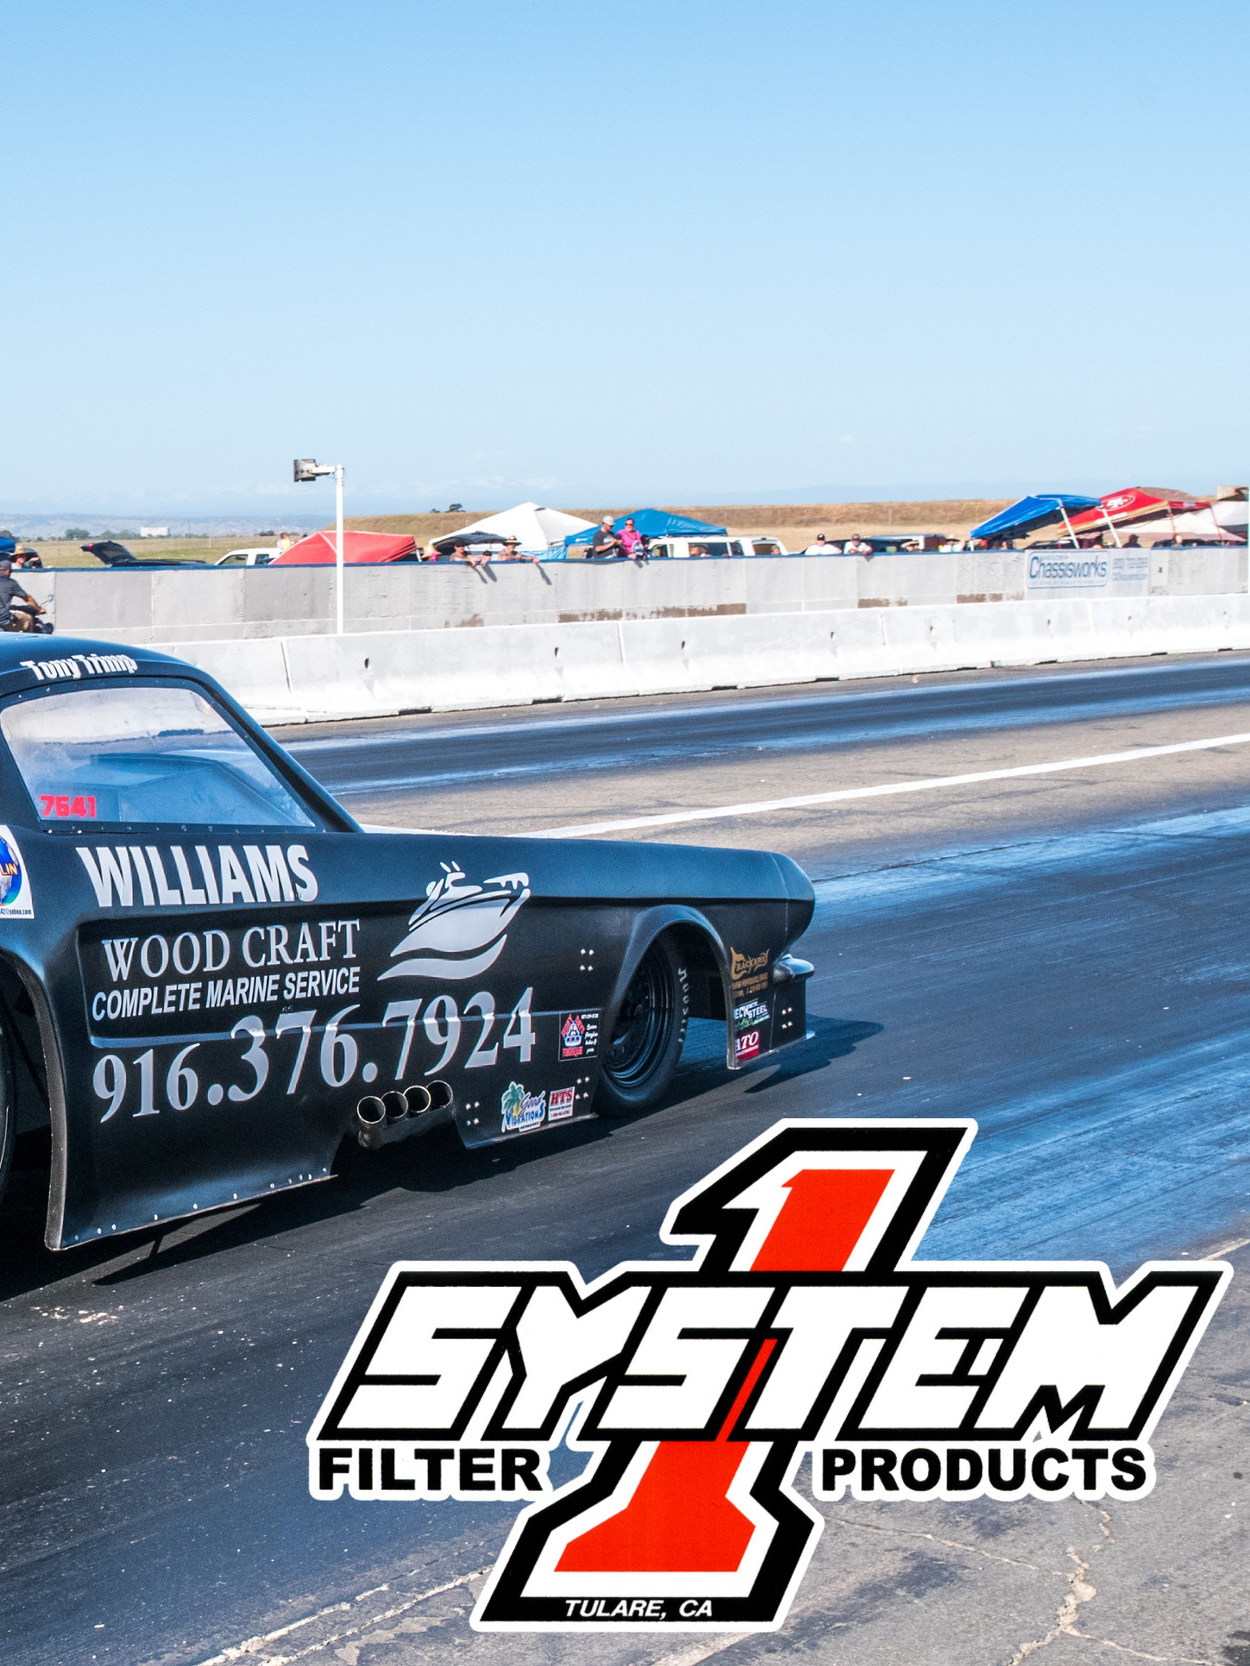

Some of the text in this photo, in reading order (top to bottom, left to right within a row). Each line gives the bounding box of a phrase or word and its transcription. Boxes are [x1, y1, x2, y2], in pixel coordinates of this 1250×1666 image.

[1030, 556, 1107, 578] Chassisworks
[19, 653, 138, 680] Tony Trimp
[40, 795, 96, 818] 7641
[75, 844, 319, 908] WILLIAMS
[101, 918, 361, 983] WOOD CRAFT
[91, 966, 361, 1022] COMPLETE MARINE SERVICE
[92, 987, 536, 1124] 916.376.7924
[550, 1090, 573, 1106] HTS
